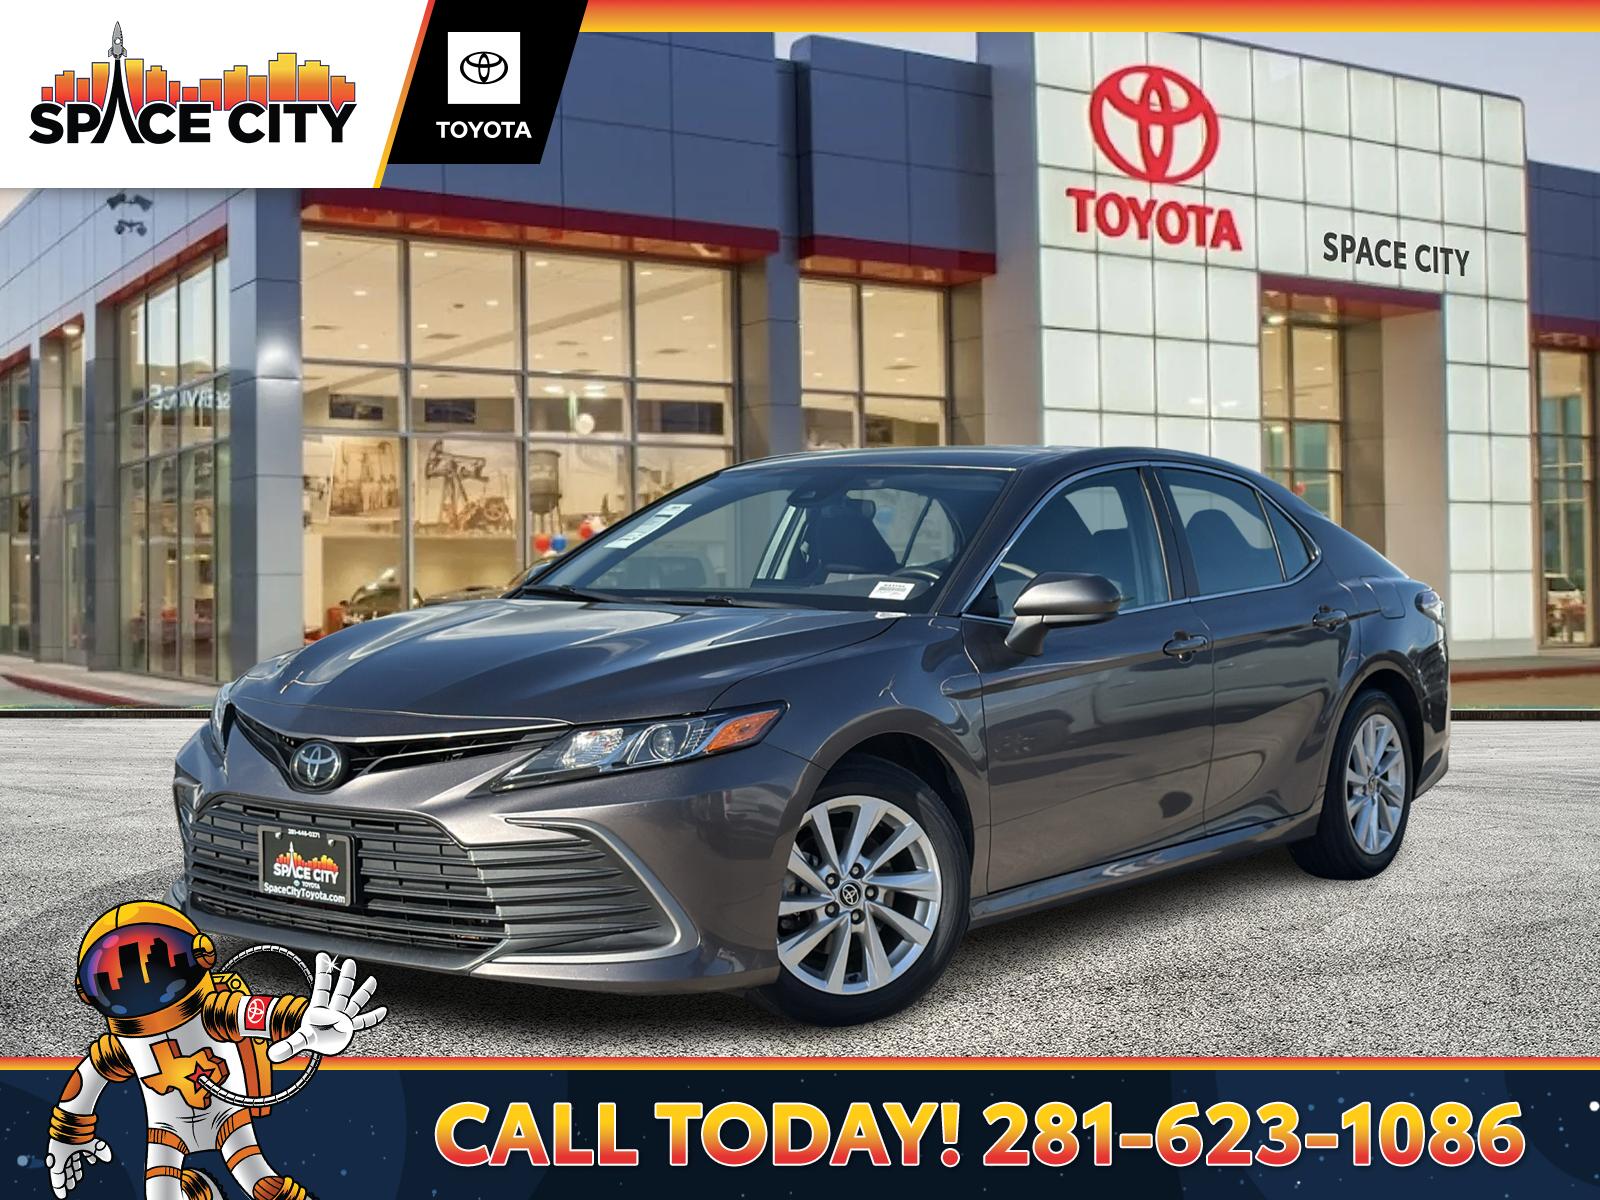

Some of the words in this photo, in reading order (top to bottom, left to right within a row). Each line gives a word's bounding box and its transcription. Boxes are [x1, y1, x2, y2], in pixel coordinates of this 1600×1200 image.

[1065, 187, 1243, 251] TOYOTA
[1323, 231, 1407, 270] SPACE
[1414, 243, 1470, 277] CITY
[273, 852, 312, 880] SPACE
[312, 868, 339, 885] CITY
[302, 880, 320, 889] TOYOTA
[264, 882, 346, 903] SpaceCityToyota.com
